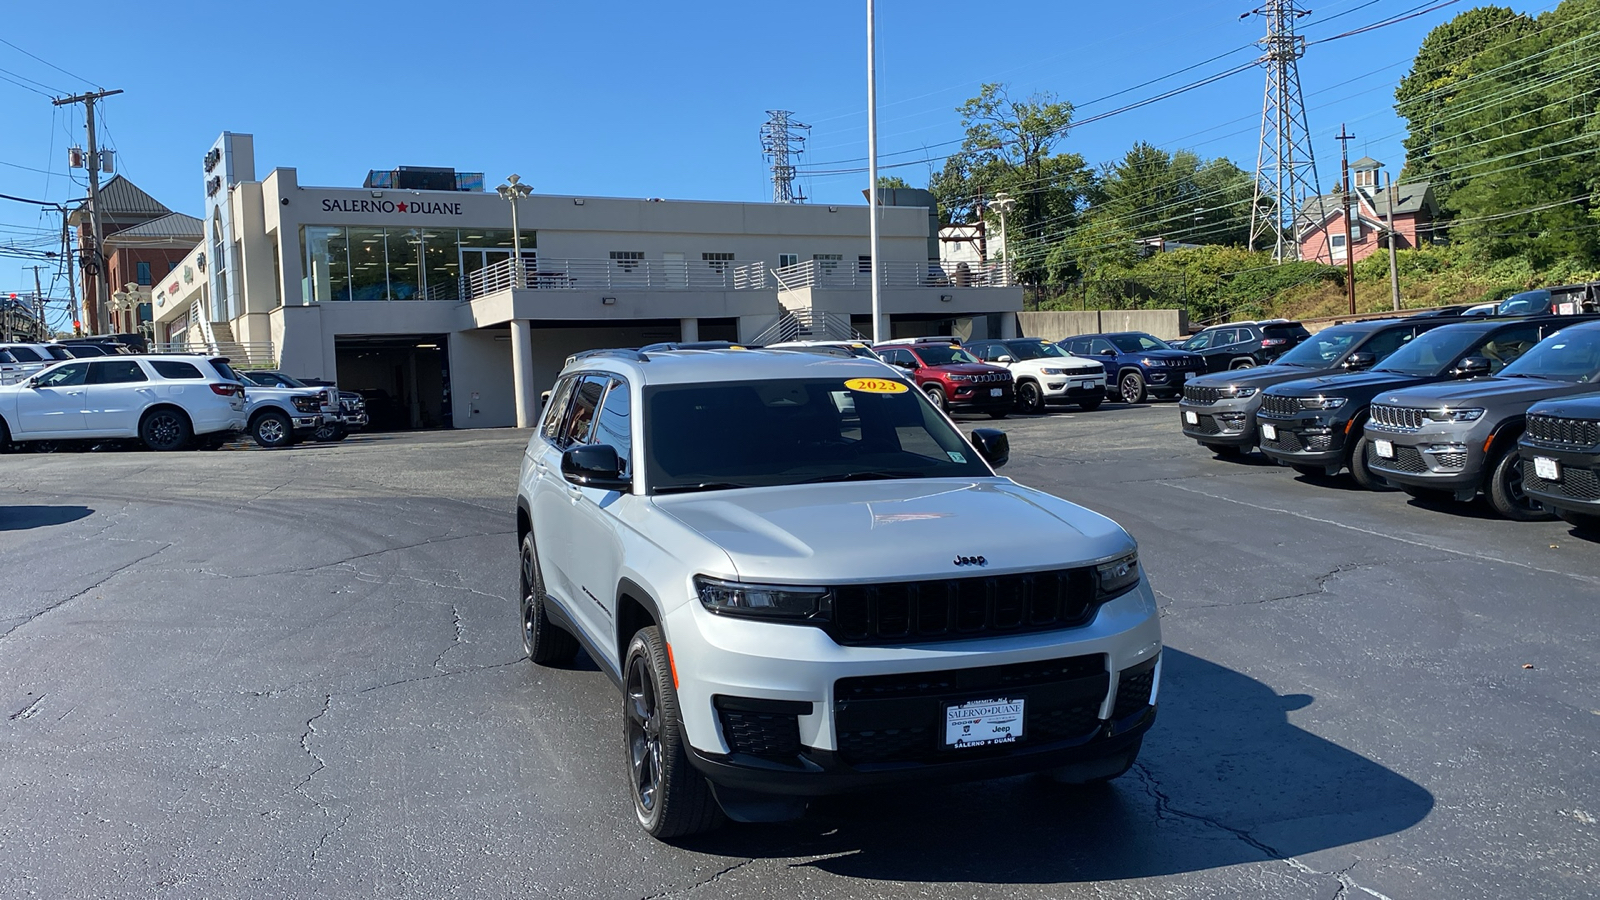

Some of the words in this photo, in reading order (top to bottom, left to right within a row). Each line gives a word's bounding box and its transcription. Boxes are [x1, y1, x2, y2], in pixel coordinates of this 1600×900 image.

[322, 199, 395, 213] SALERNO
[410, 202, 463, 215] DUANE
[857, 381, 896, 390] 2023
[953, 554, 986, 567] Jeep
[948, 707, 987, 719] SALERNO
[991, 704, 1021, 714] DUANE
[954, 740, 985, 749] SALERNO
